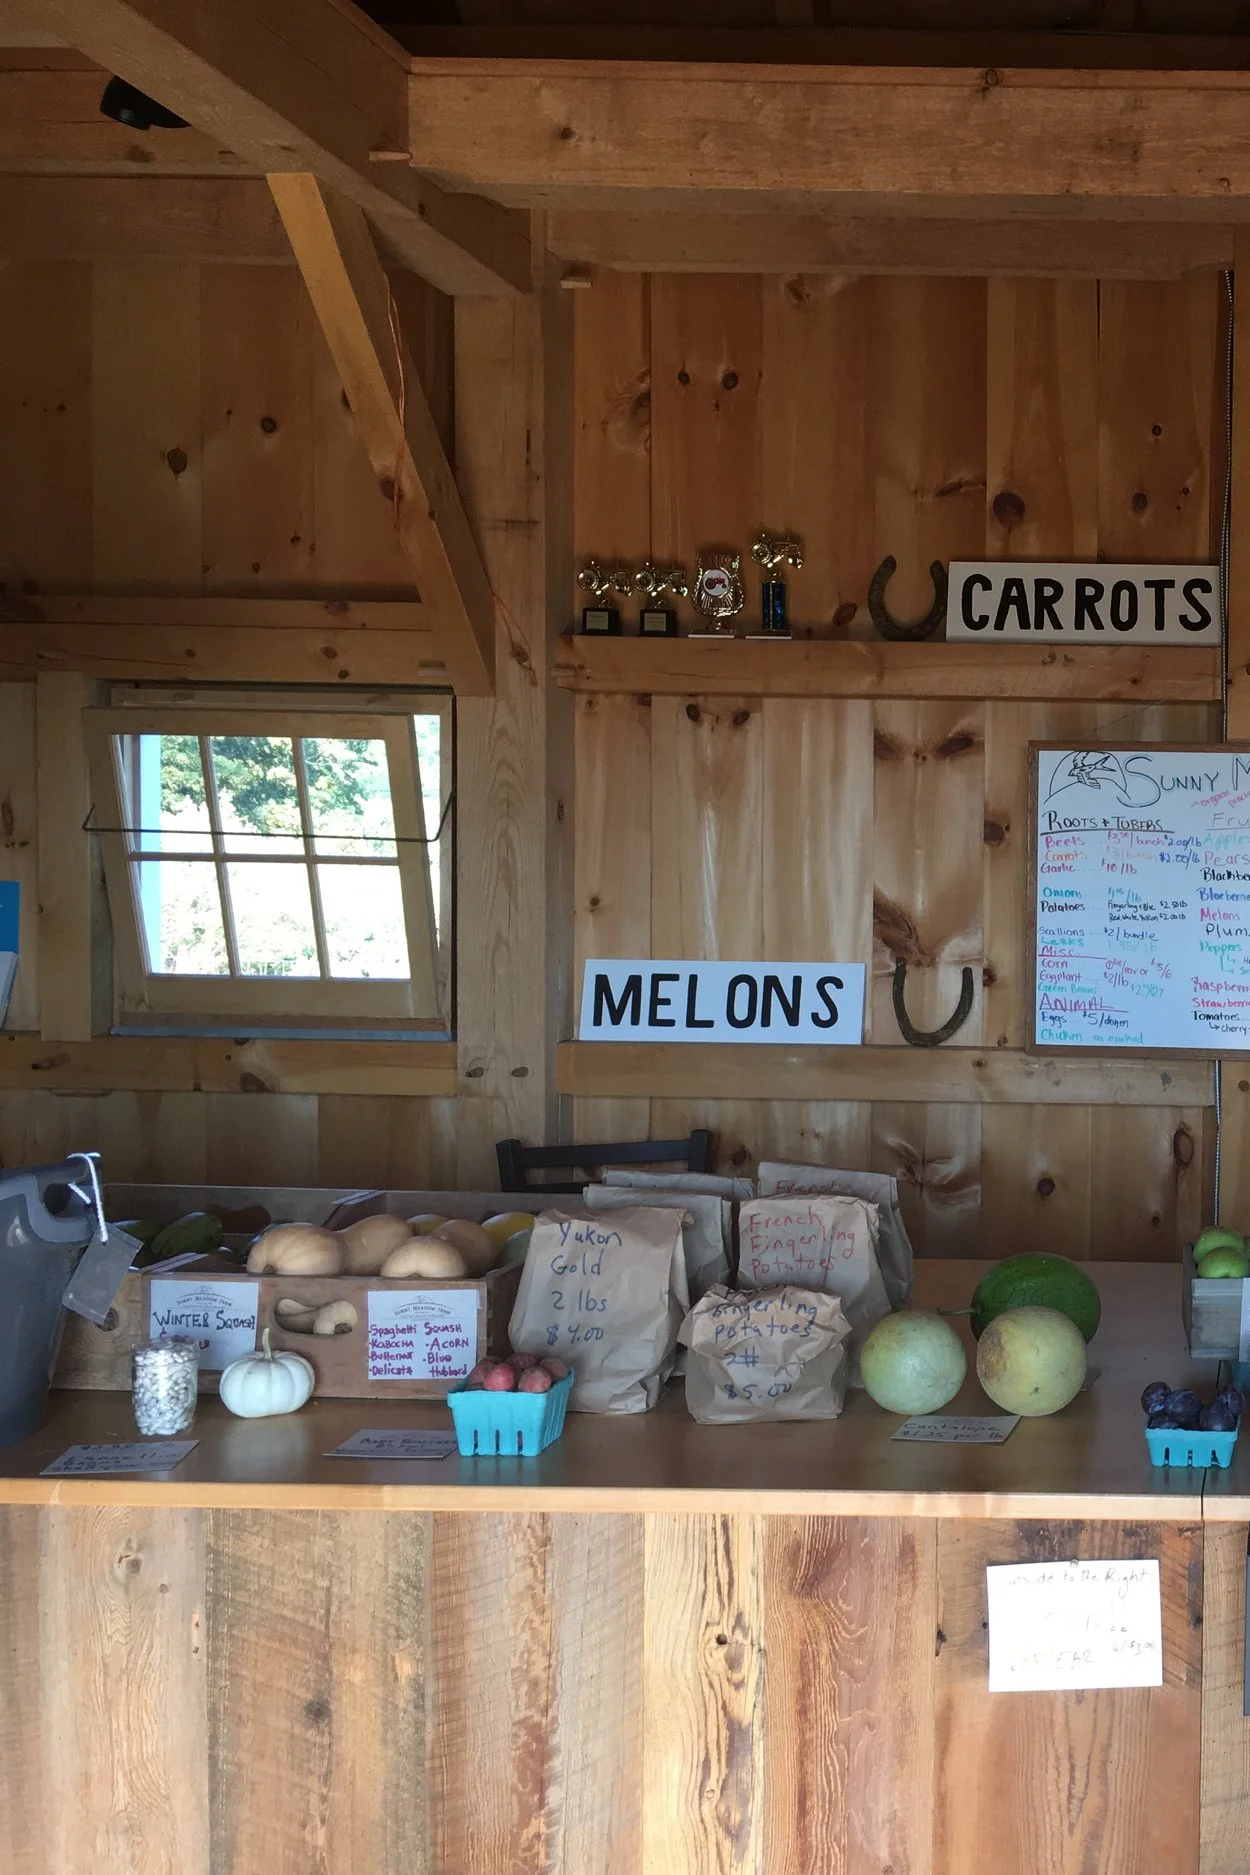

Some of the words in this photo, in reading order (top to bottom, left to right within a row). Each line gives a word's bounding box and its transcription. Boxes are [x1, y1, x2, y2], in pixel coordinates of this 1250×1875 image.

[961, 573, 1212, 633] CARROTS
[1116, 755, 1219, 808] SUNNY
[1042, 810, 1098, 831] ROOTS
[1111, 816, 1164, 831] TUBERS
[1045, 835, 1085, 850] Beets
[1200, 907, 1240, 921] Melons
[1039, 969, 1082, 984] Eggplant
[593, 973, 845, 1029] MELONS
[1042, 1011, 1067, 1028] Eggs
[1191, 1010, 1240, 1021] Tomatoes
[1221, 1022, 1247, 1037] cherry
[749, 1206, 822, 1233] French
[559, 1221, 622, 1246] Yukon
[751, 1226, 856, 1259] Fingerling
[550, 1248, 605, 1275] Gold
[551, 1290, 565, 1310] 2
[578, 1289, 607, 1312] lbs
[153, 1309, 210, 1327] WINTER
[216, 1309, 256, 1330] SQUASH
[370, 1324, 417, 1339] Spaghetti
[427, 1352, 452, 1364] Blue
[372, 1363, 413, 1375] Delicata
[429, 1364, 467, 1378] Hubbard
